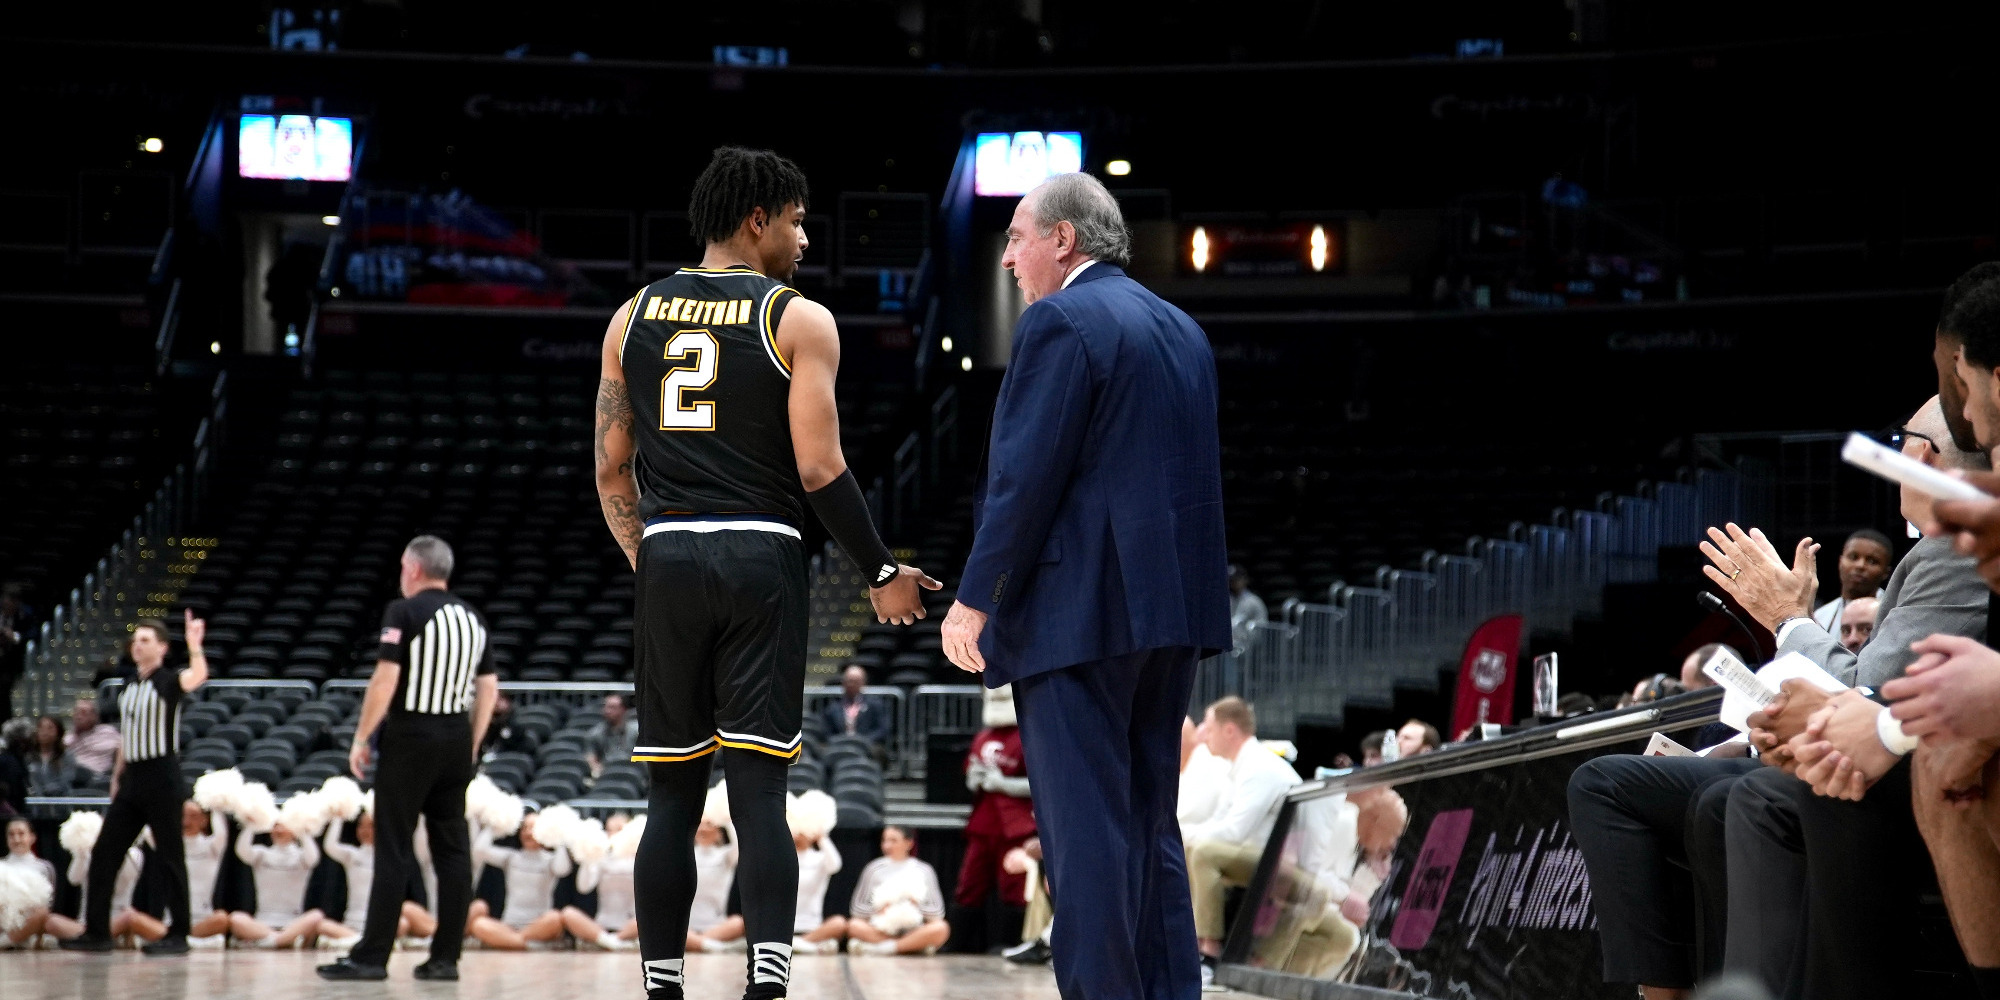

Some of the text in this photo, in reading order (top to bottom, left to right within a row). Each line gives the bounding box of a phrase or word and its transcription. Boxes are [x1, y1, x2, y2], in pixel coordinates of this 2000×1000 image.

[643, 296, 752, 325] McKEITHAN
[659, 328, 720, 431] 2
[1458, 831, 1507, 950] Pay
[1486, 823, 1524, 927] in
